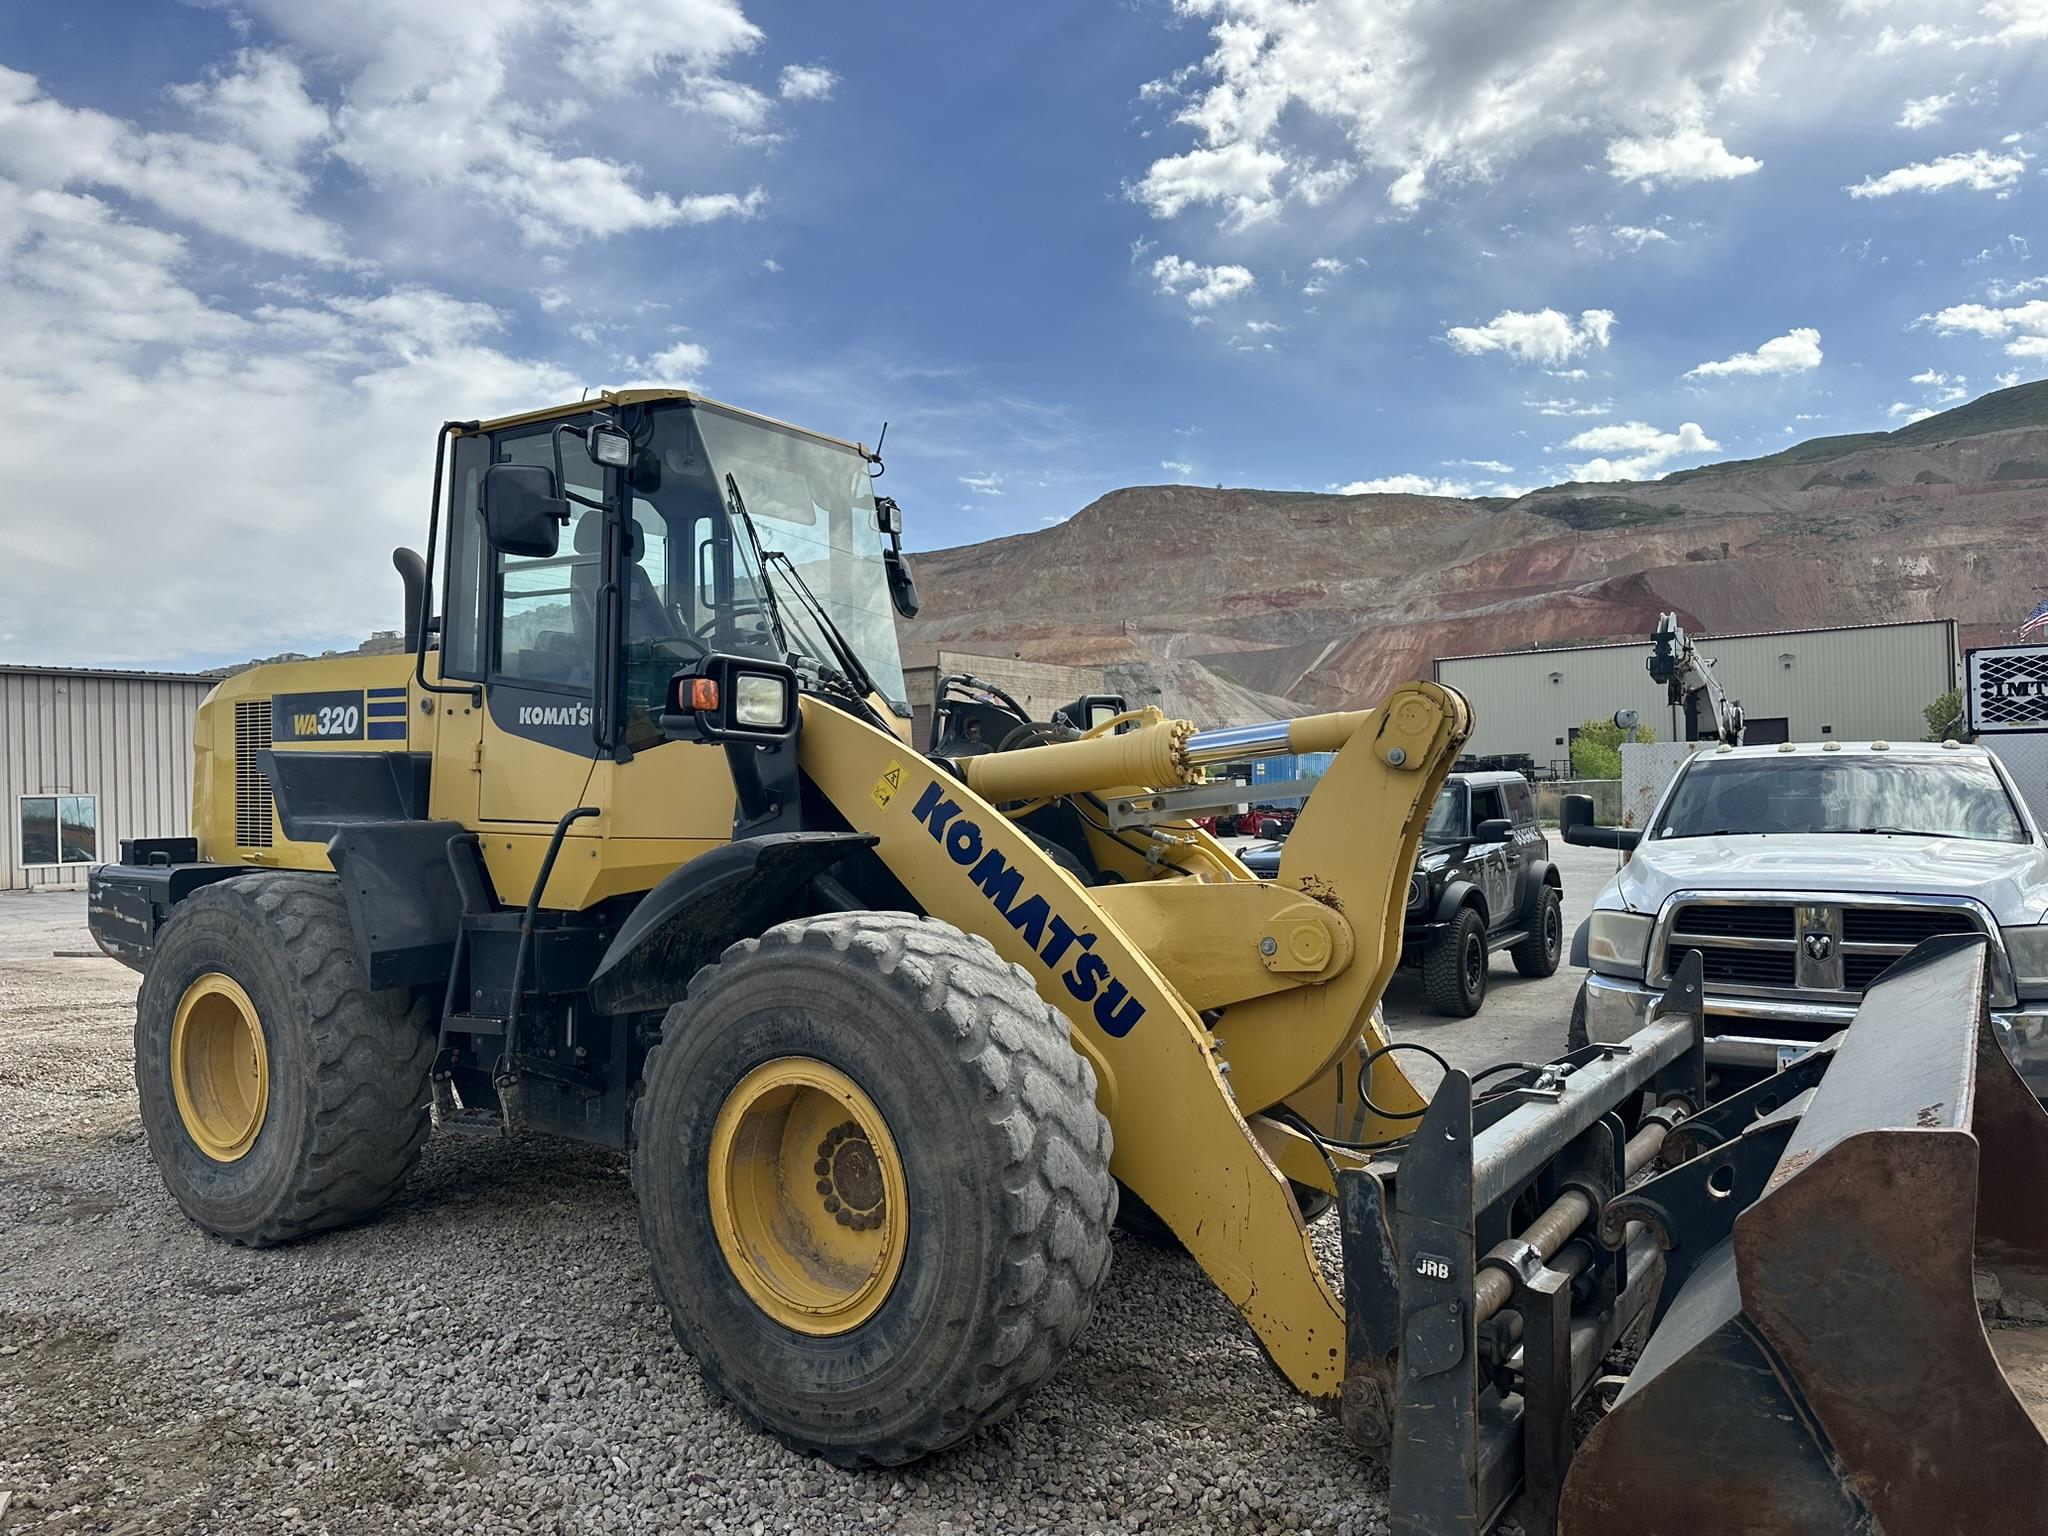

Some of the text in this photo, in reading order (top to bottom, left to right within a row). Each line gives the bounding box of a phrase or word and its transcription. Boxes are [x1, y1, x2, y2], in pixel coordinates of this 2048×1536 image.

[1993, 680, 2048, 698] IMT
[911, 780, 1146, 1038] KOMATSU
[1416, 1259, 1449, 1279] JRB
